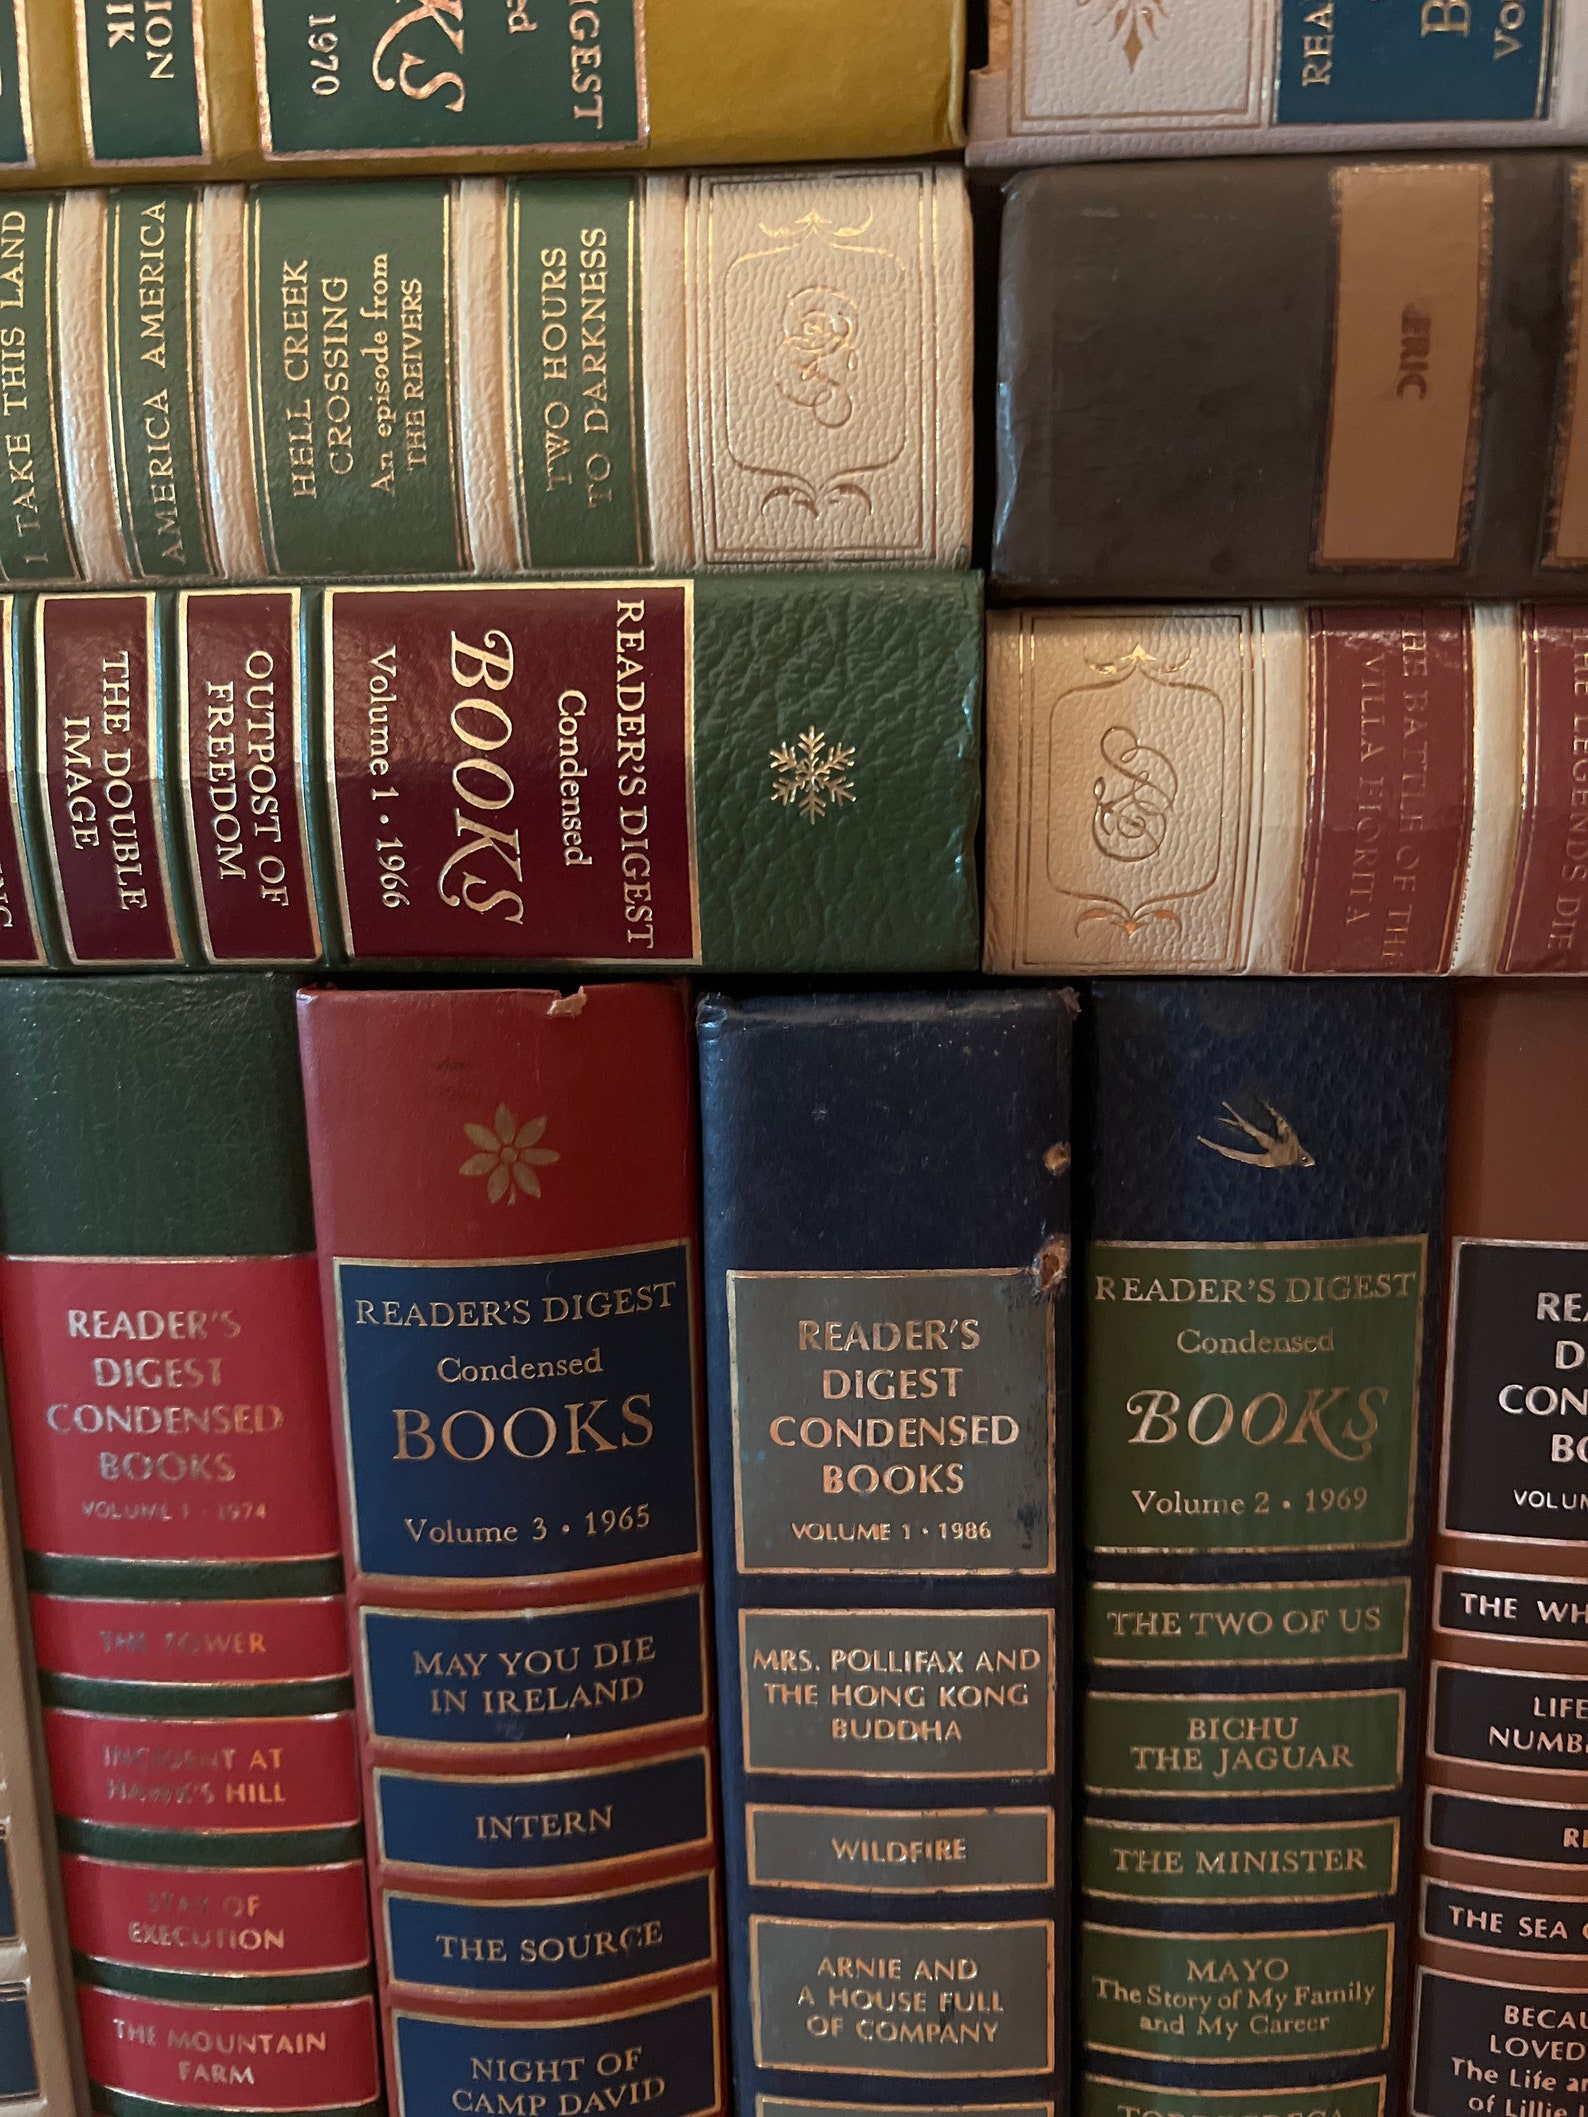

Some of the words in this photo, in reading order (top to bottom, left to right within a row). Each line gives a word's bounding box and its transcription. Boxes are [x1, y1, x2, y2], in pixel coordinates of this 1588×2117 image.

[308, 14, 341, 96] 1970
[1301, 0, 1336, 88] REA
[1, 210, 27, 309] LAND
[140, 200, 168, 369] AMERICA
[374, 252, 390, 318] from
[283, 259, 309, 382] CREEK
[541, 247, 570, 379] HOURS
[580, 228, 609, 435] DARKNESS
[399, 279, 426, 400] REIVERS
[2, 326, 27, 417] THIS
[322, 276, 354, 475] CROSSING
[361, 327, 395, 437] episode
[286, 401, 318, 499] HELL
[405, 411, 429, 471] THE
[544, 400, 573, 490] TWO
[7, 433, 42, 537] TAKE
[144, 389, 187, 563] AMERICA
[371, 450, 396, 497] An
[584, 452, 613, 508] TO
[100, 651, 131, 735] THE
[367, 645, 397, 777] Volume
[616, 599, 648, 797] READER'S
[1360, 654, 1386, 763] VILLA
[245, 650, 284, 843] OUTPOST
[1401, 690, 1428, 833] BATTLE
[63, 716, 100, 851] IMAGE
[206, 681, 246, 880] FREEDOM
[371, 786, 394, 802] 1
[438, 629, 524, 925] BOOKS
[556, 690, 592, 866] Condensed
[104, 749, 149, 911] DOUBLE
[1345, 776, 1386, 926] FIORITA
[1393, 845, 1421, 892] OF
[257, 858, 290, 908] OF
[376, 836, 410, 909] 1966
[618, 805, 654, 949] DIGEST
[1548, 895, 1582, 950] DIE
[355, 1298, 531, 1328] READER'S
[542, 1281, 677, 1325] DIGEST
[1095, 1274, 1276, 1304] READER'S
[1284, 1270, 1416, 1304] DIGEST
[67, 1309, 242, 1342] READER'S
[1537, 1292, 1588, 1323] RE
[798, 1318, 981, 1352] READER'S
[1176, 1328, 1335, 1355] Condensed
[93, 1357, 225, 1388] DIGEST
[437, 1347, 604, 1383] Condensed
[822, 1367, 964, 1401] DIGEST
[46, 1403, 285, 1435] CONDENSED
[1498, 1384, 1588, 1416] CON
[392, 1393, 655, 1463] BOOKS
[769, 1414, 1021, 1449] CONDENSED
[1126, 1385, 1390, 1463] BOOKS
[99, 1451, 236, 1483] BOOKS
[822, 1463, 965, 1495] BOOKS
[80, 1501, 173, 1522] VOLUME
[1131, 1489, 1245, 1516] Volume
[1253, 1490, 1271, 1515] 2
[1304, 1486, 1369, 1513] 1969
[404, 1517, 519, 1544] Volume
[532, 1517, 548, 1542] 3
[584, 1503, 651, 1537] 1965
[790, 1521, 891, 1541] VOLUME
[901, 1522, 911, 1541] 1
[937, 1520, 992, 1541] 1986
[1106, 1610, 1182, 1638] THE
[1189, 1608, 1275, 1637] TWO
[1281, 1609, 1330, 1635] OF
[1338, 1606, 1382, 1634] US
[1459, 1592, 1519, 1620] THE
[413, 1649, 488, 1679] MAY
[498, 1647, 581, 1678] YOU
[593, 1635, 657, 1670] DIE
[752, 1647, 820, 1674] MRS.
[830, 1649, 964, 1675] POLLIFAX
[975, 1647, 1042, 1673] AND
[430, 1688, 467, 1713] IN
[483, 1676, 645, 1715] IRELAND
[763, 1682, 818, 1707] THE
[830, 1683, 926, 1709] HONG
[938, 1682, 1030, 1708] KONG
[831, 1717, 963, 1743] BUDDHA
[1186, 1716, 1301, 1743] BICHU
[1489, 1725, 1588, 1754] NUMB
[249, 1748, 283, 1769] AT
[1128, 1745, 1204, 1772] THE
[1212, 1744, 1354, 1779] JAGUAR
[226, 1783, 286, 1804] HILL
[475, 1804, 615, 1841] INTERN
[831, 1836, 968, 1864] WILDFIRE
[1112, 1847, 1184, 1875] THE
[1195, 1847, 1368, 1876] MINISTER
[222, 1895, 261, 1917] OF
[1448, 1905, 1504, 1934] THE
[1518, 1916, 1568, 1940] SEA
[128, 1921, 286, 1951] EXECUTION
[435, 1935, 509, 1963] THE
[519, 1920, 664, 1964] SOURCE
[816, 1955, 903, 1981] ARNIE
[913, 1957, 979, 1982] AND
[1186, 1958, 1290, 1984] MAYO
[797, 1987, 816, 2009] A
[828, 1988, 927, 2014] HOUSE
[938, 1990, 1005, 2014] FULL
[1091, 1975, 1142, 2007] The
[1146, 1984, 1213, 2016] Story
[1217, 1985, 1242, 2009] of
[1247, 1987, 1288, 2013] My
[1293, 1981, 1377, 2008] Family
[112, 2018, 157, 2047] THE
[167, 2031, 327, 2056] MOUNTAIN
[805, 2014, 845, 2040] OF
[855, 2017, 1000, 2045] COMPANY
[1139, 2014, 1184, 2036] and
[1196, 2017, 1240, 2042] My
[1249, 2014, 1331, 2036] Career
[470, 2056, 586, 2083] NIGHT
[595, 2045, 645, 2075] OF
[1490, 2034, 1586, 2062] LOVED
[178, 2060, 256, 2085] FARM
[1451, 2056, 1499, 2084] The
[1510, 2068, 1557, 2092] Life
[451, 2087, 548, 2117] CAMP
[558, 2075, 667, 2117] DAVID
[1468, 2094, 1496, 2114] of
